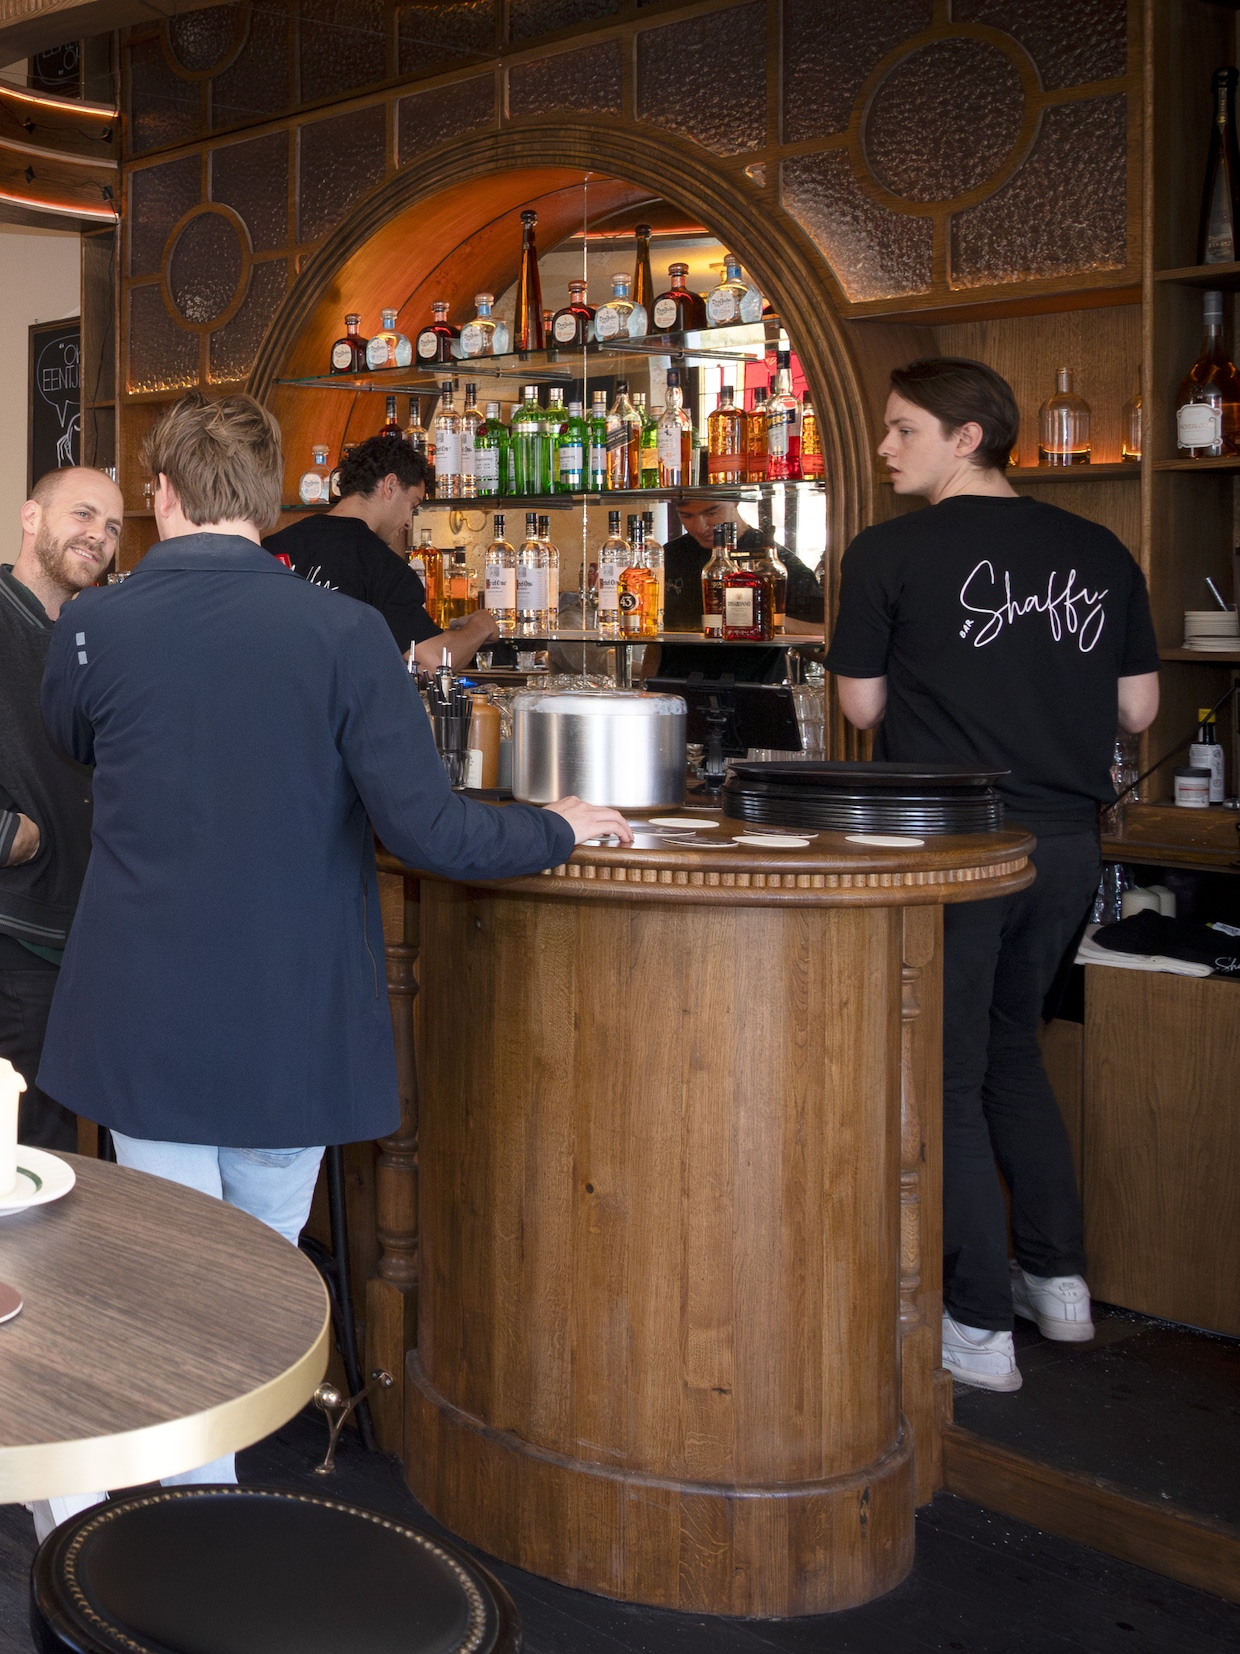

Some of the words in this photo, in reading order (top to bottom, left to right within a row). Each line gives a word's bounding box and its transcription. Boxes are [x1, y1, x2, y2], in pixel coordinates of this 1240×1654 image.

[43, 364, 80, 391] EENTJ
[620, 596, 632, 607] 43
[960, 560, 1109, 652] Shaffy
[959, 619, 974, 639] BAR
